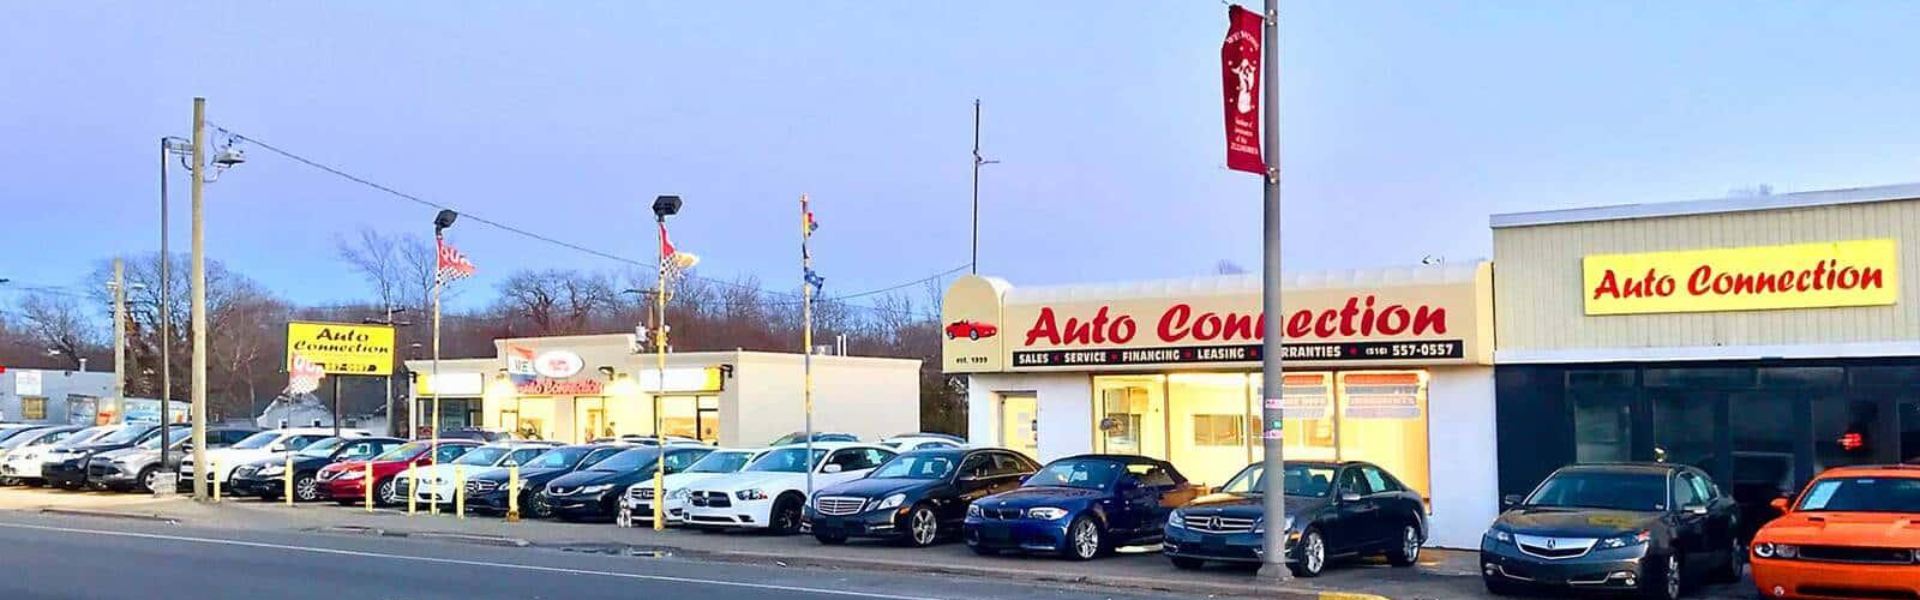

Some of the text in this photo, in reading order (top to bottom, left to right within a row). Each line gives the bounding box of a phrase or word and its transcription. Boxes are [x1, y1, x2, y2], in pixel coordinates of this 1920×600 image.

[1594, 258, 1883, 299] Auto Connection
[316, 328, 369, 340] Auto
[1024, 305, 1136, 346] Auto
[293, 340, 388, 353] Connection
[1019, 353, 1049, 364] SALES
[1064, 351, 1107, 363] SERVICE
[1122, 349, 1180, 363] FINANCING
[1198, 347, 1245, 360] LEASING
[1281, 346, 1342, 360] RRANTIES
[1392, 343, 1454, 357] 557-0557
